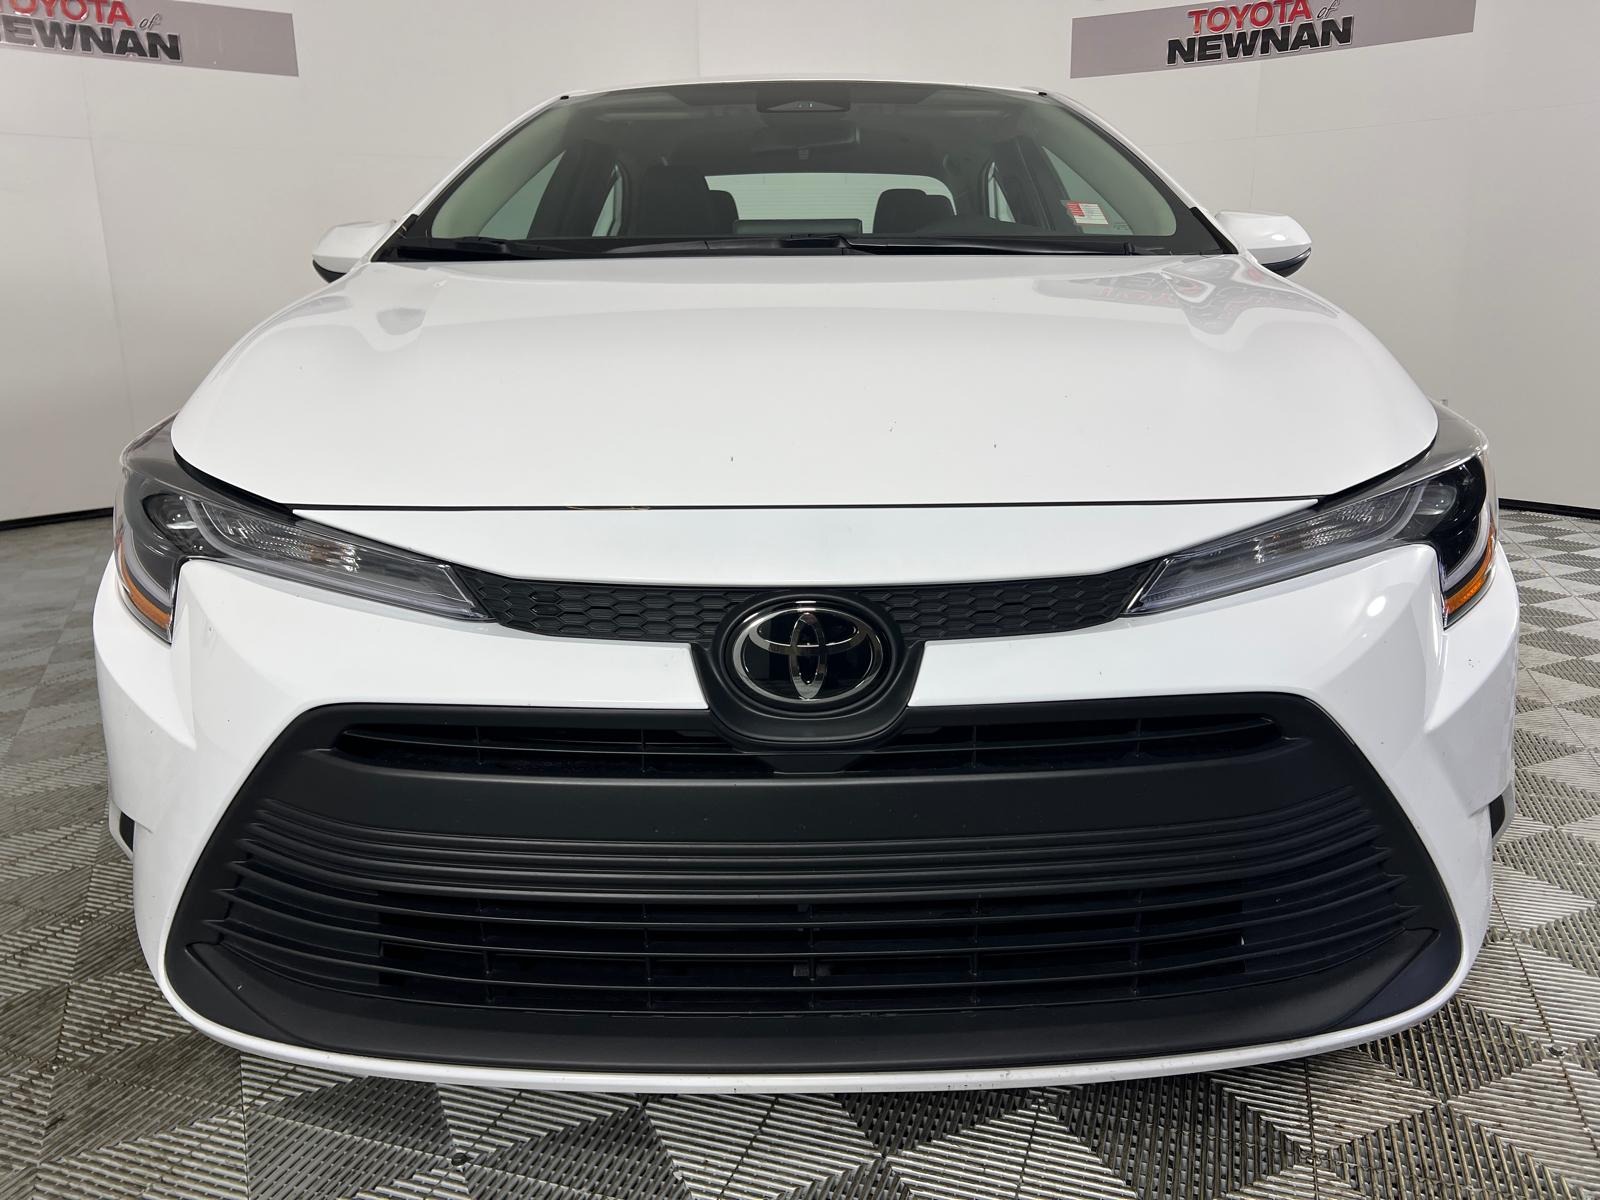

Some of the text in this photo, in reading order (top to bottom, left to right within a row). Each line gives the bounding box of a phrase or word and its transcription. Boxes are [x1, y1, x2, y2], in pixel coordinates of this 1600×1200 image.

[0, 0, 161, 29] OYOTA of
[1187, 0, 1339, 35] TOYOTA of
[0, 14, 181, 61] EWNAN
[1166, 16, 1353, 65] NEWNAN
